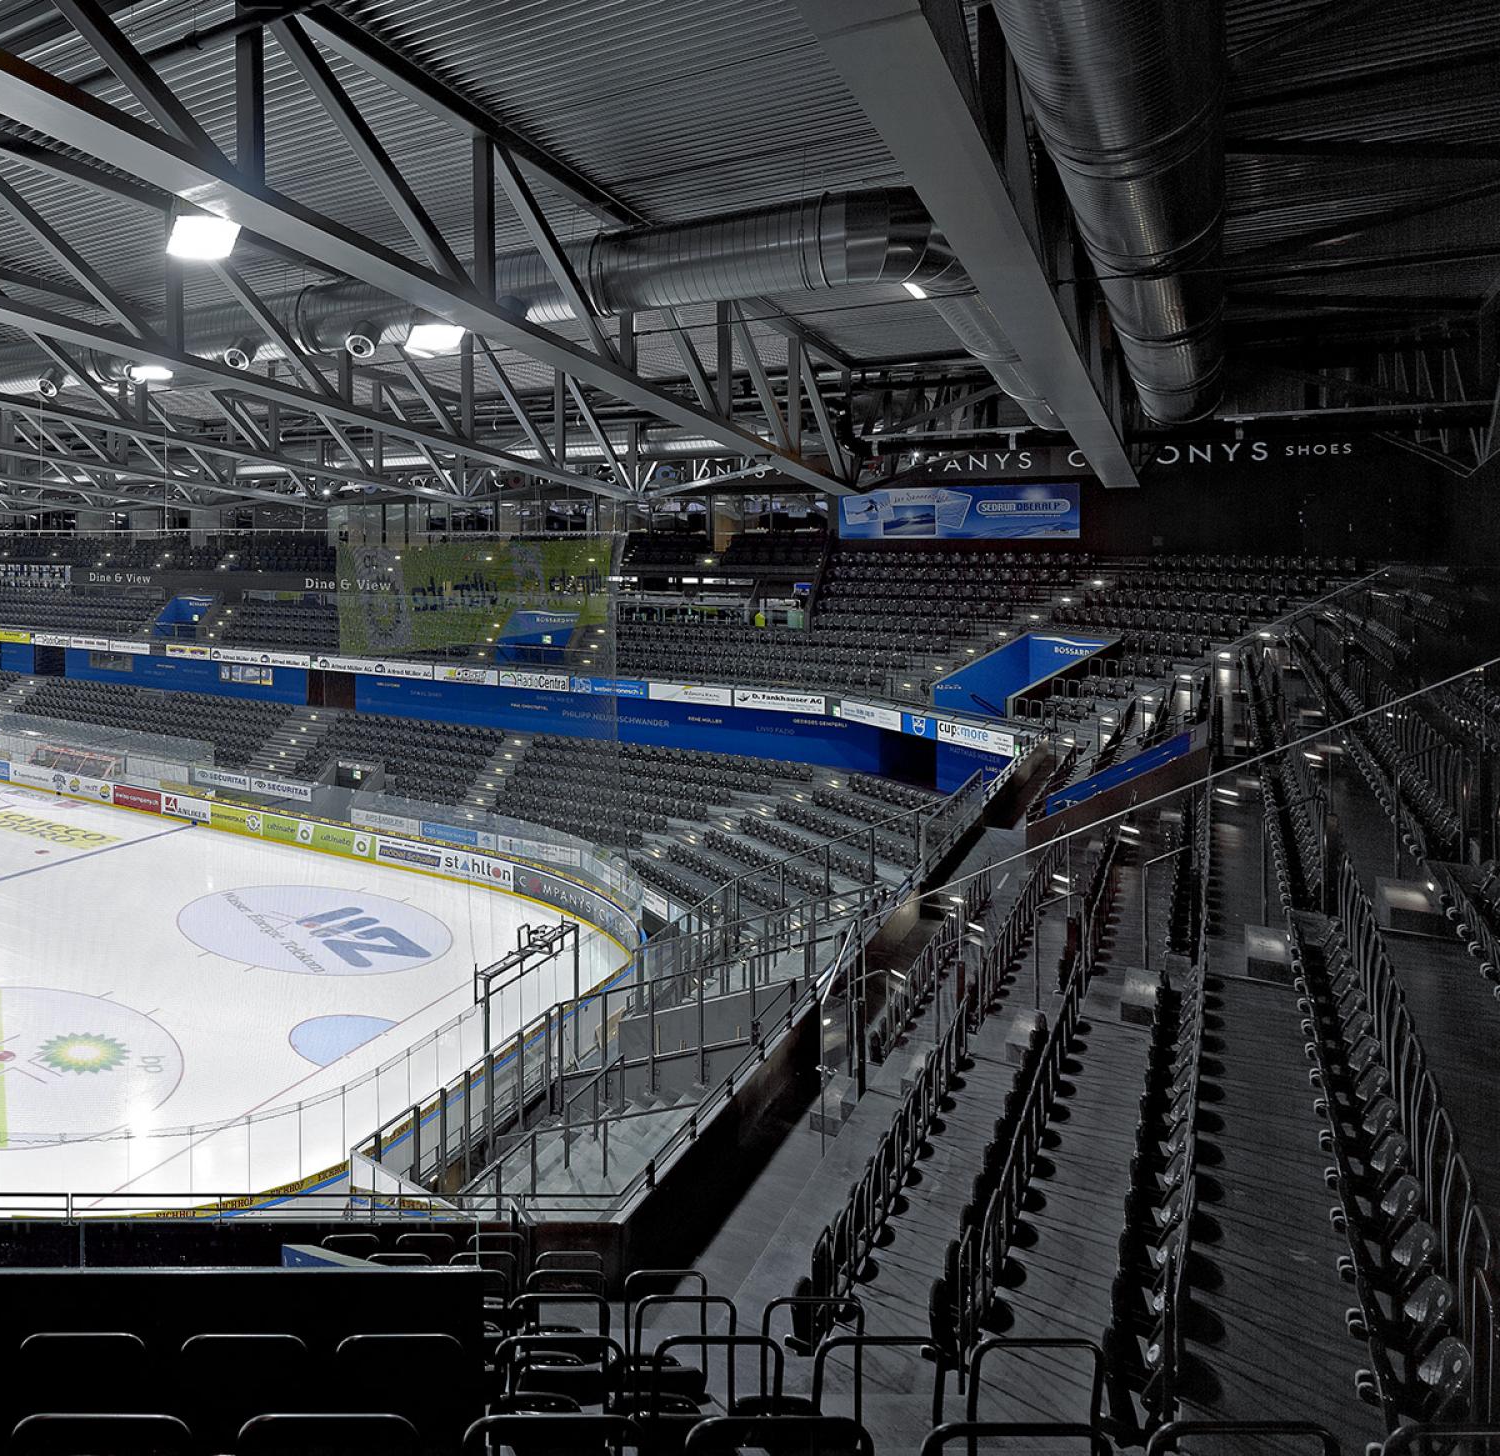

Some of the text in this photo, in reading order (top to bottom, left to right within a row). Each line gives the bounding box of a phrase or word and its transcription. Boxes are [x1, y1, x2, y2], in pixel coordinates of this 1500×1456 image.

[1285, 443, 1353, 456] SHOES
[89, 572, 151, 584] Dine & View
[304, 577, 392, 591] Dine & View
[516, 673, 567, 691] RadioCentral
[762, 694, 808, 703] Fankhauser
[810, 697, 822, 705] AG
[209, 773, 247, 786] SECURITAS
[267, 783, 309, 797] SECURITAS
